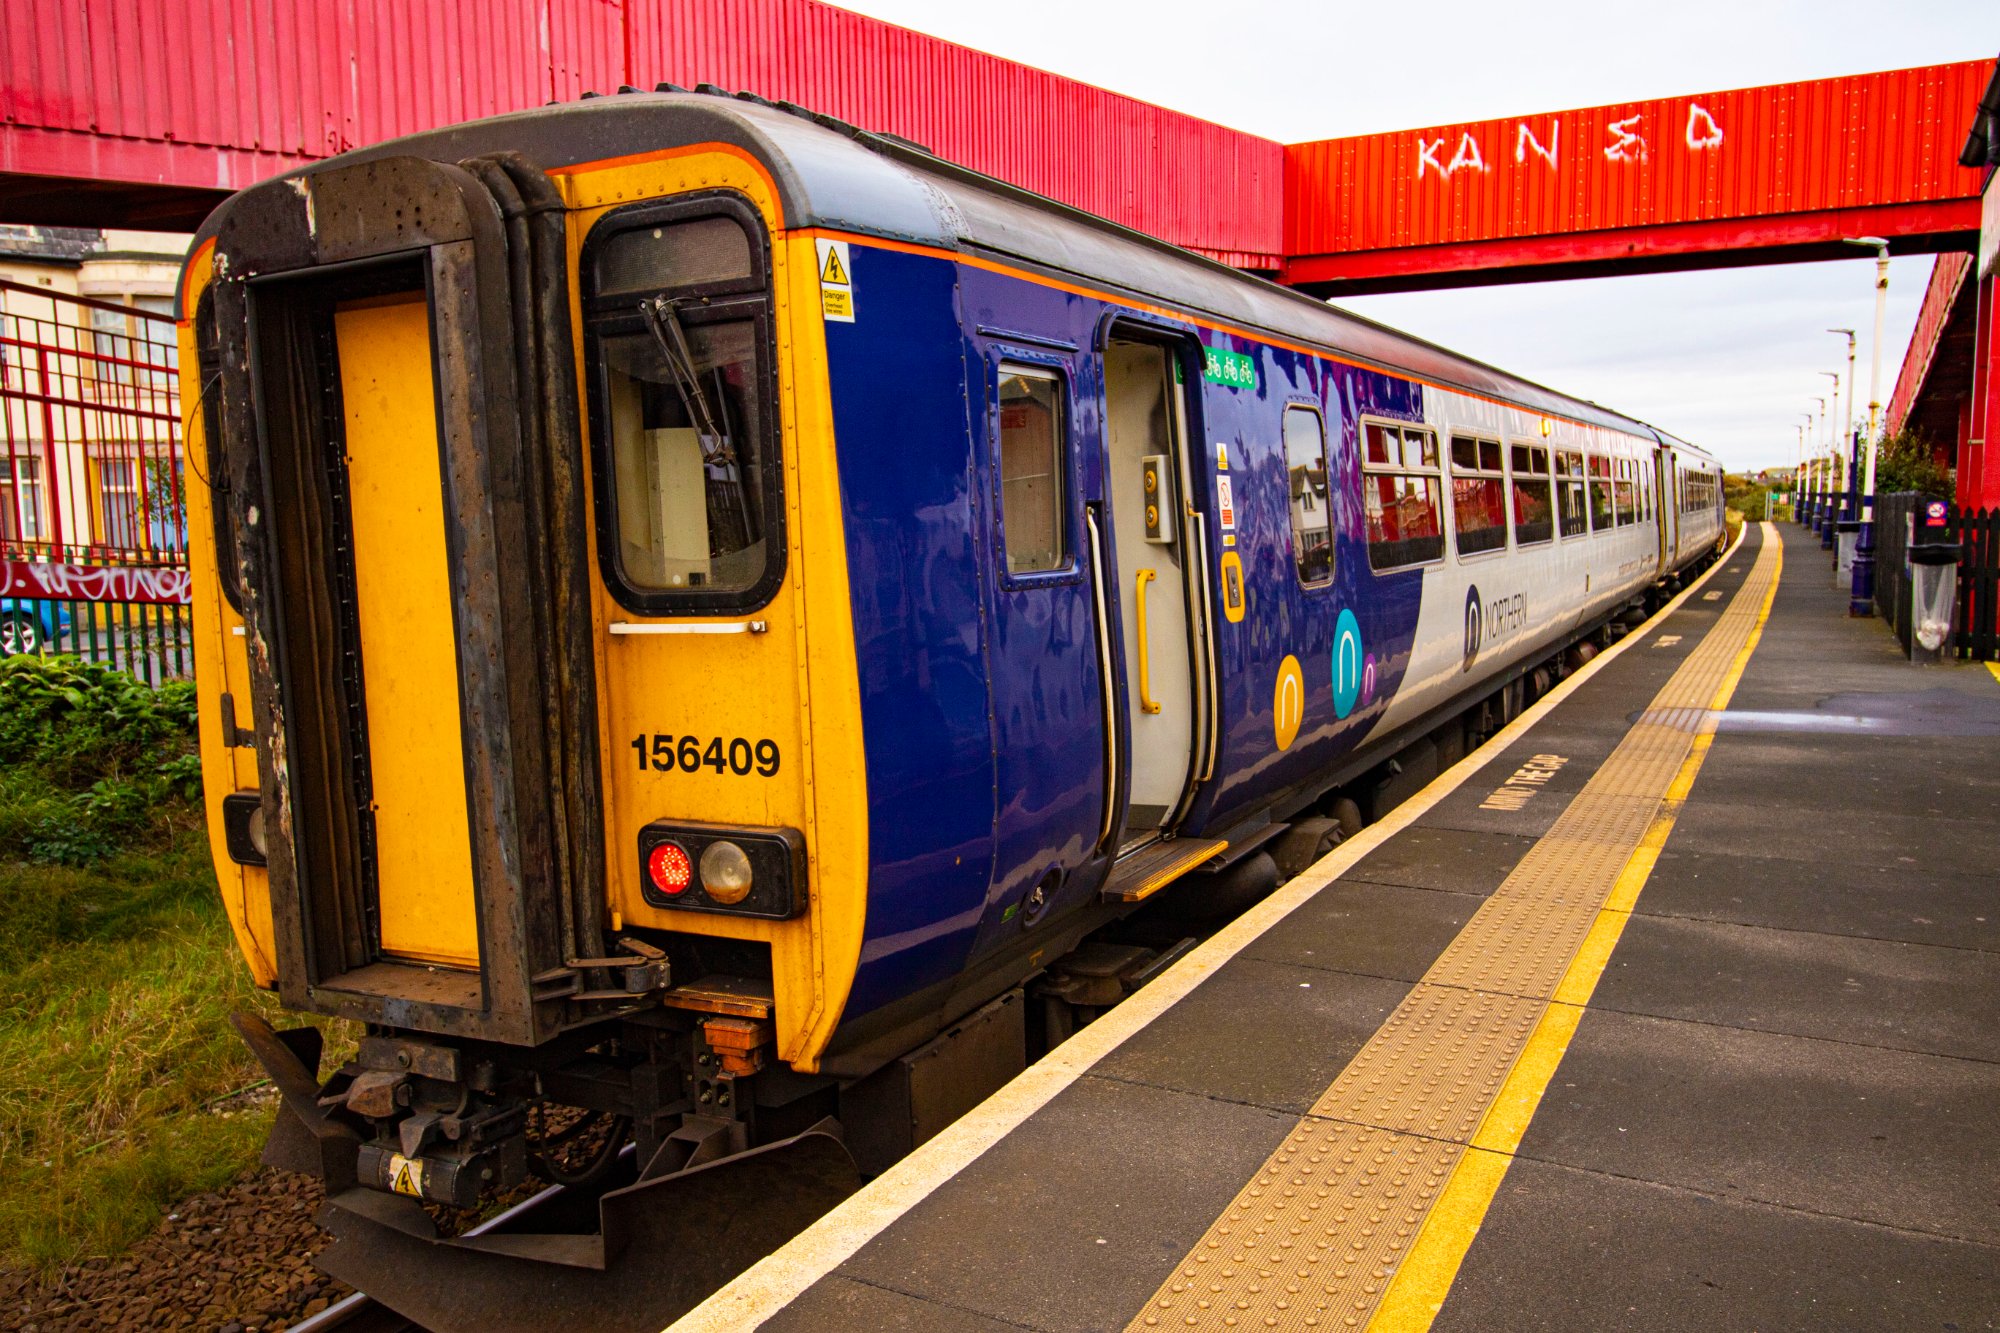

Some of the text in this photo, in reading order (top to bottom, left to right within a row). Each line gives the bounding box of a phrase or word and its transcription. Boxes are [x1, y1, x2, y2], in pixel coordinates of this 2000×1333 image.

[824, 290, 845, 301] Danger
[1485, 592, 1527, 642] NORTHERN
[631, 734, 781, 777] 156409
[1523, 754, 1569, 770] GAP
[1504, 768, 1557, 786] THE
